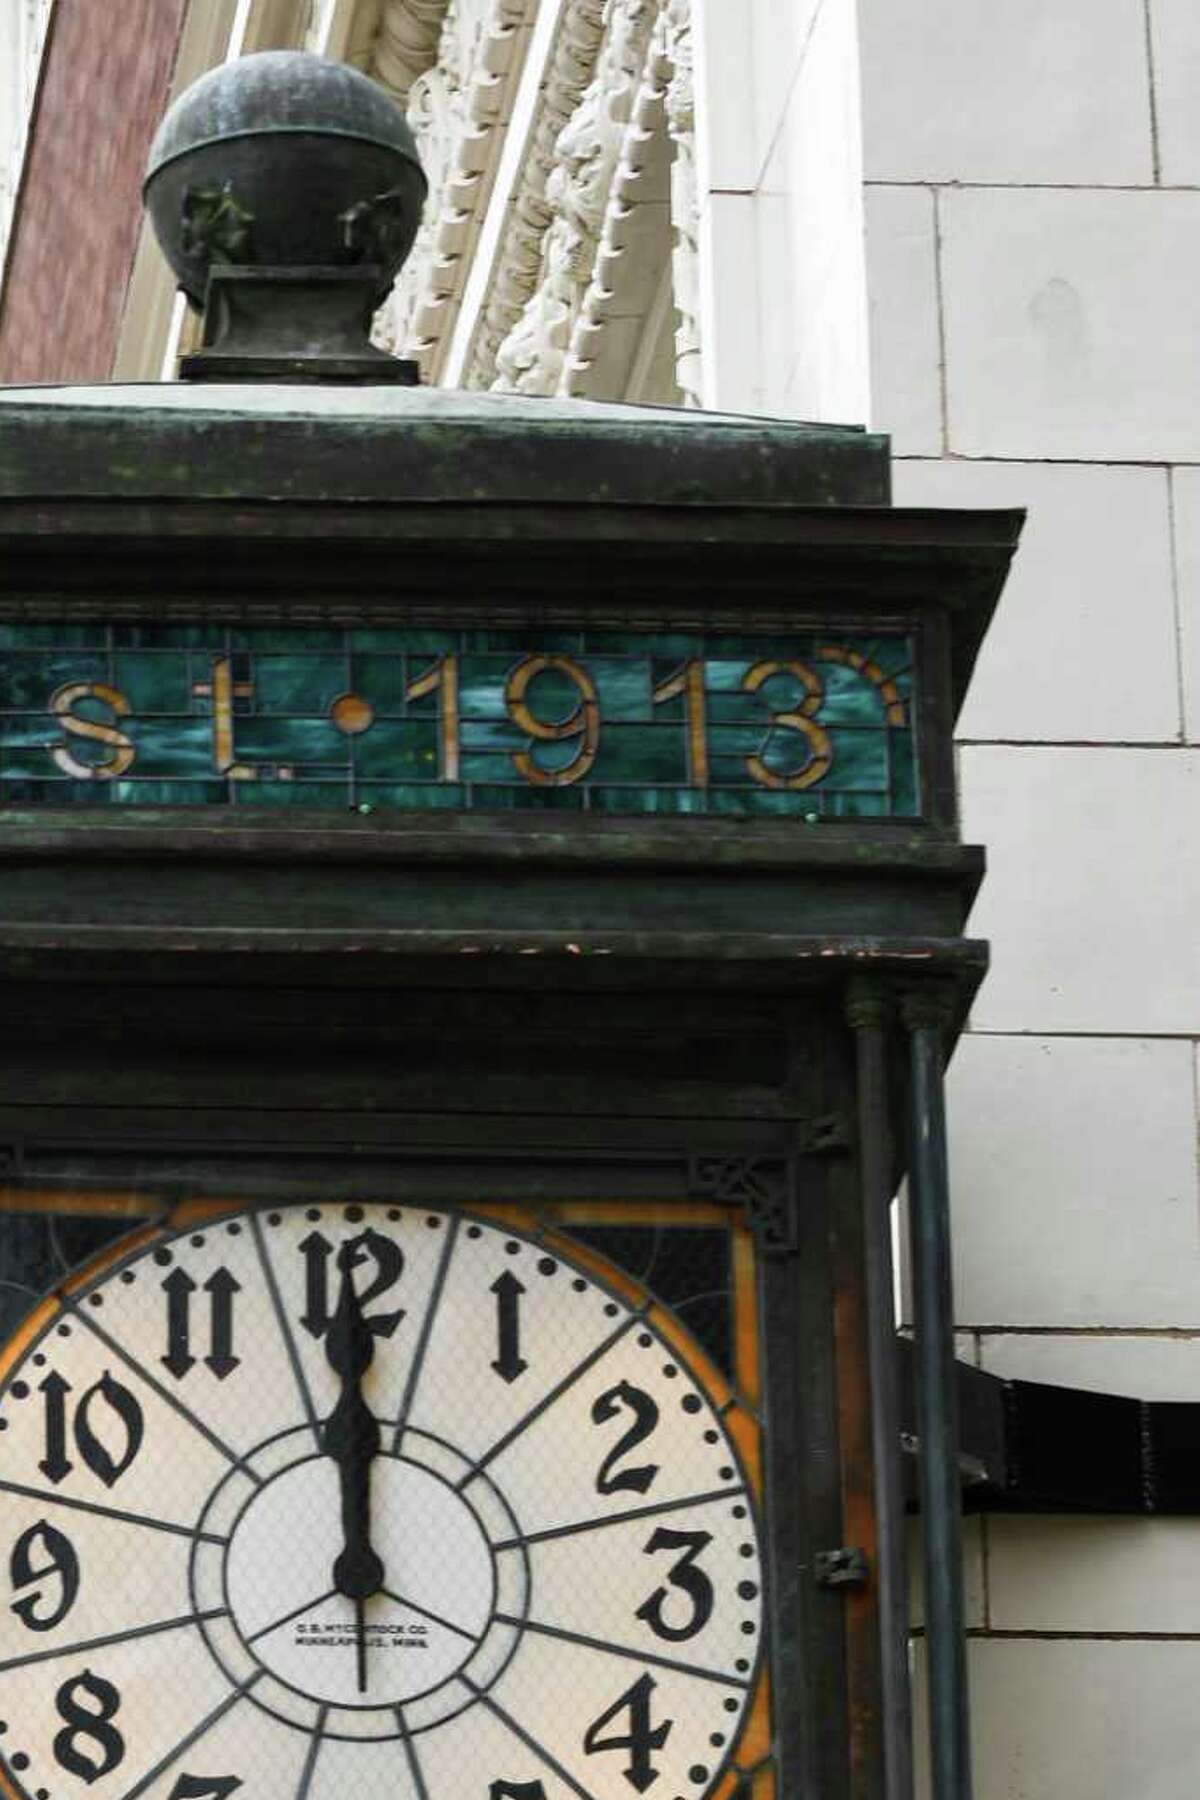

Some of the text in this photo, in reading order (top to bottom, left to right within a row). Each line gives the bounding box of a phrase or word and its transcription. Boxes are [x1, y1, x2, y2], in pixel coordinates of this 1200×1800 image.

[404, 649, 833, 789] 1913
[160, 1266, 242, 1380] 11
[298, 1226, 407, 1340] 12
[489, 1269, 528, 1385] 1
[37, 1369, 144, 1489] 10
[591, 1379, 660, 1496] 2
[10, 1518, 80, 1632] 9
[634, 1527, 714, 1643] 3
[53, 1668, 126, 1785] 8
[583, 1672, 673, 1794] 4
